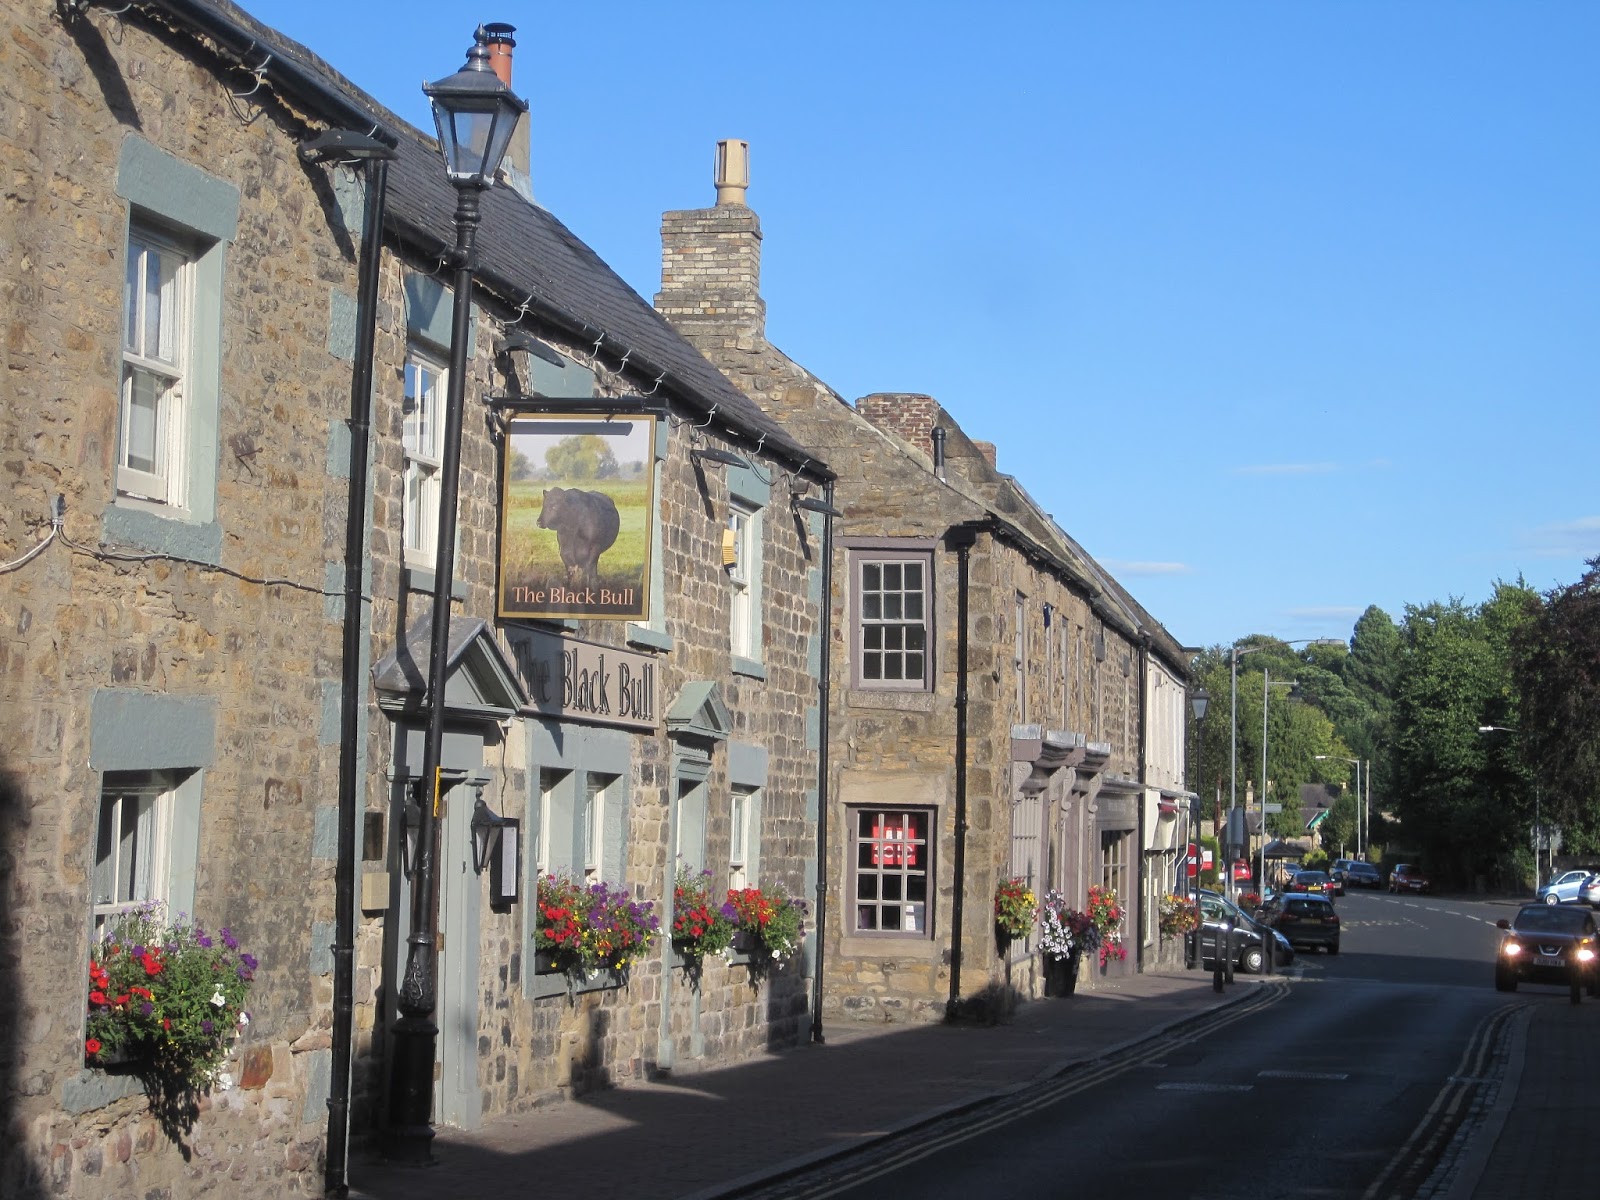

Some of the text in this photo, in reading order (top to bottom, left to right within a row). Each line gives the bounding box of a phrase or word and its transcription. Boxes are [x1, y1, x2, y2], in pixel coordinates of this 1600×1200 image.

[512, 586, 634, 606] The Black Bull
[513, 637, 654, 722] The Black Bull
